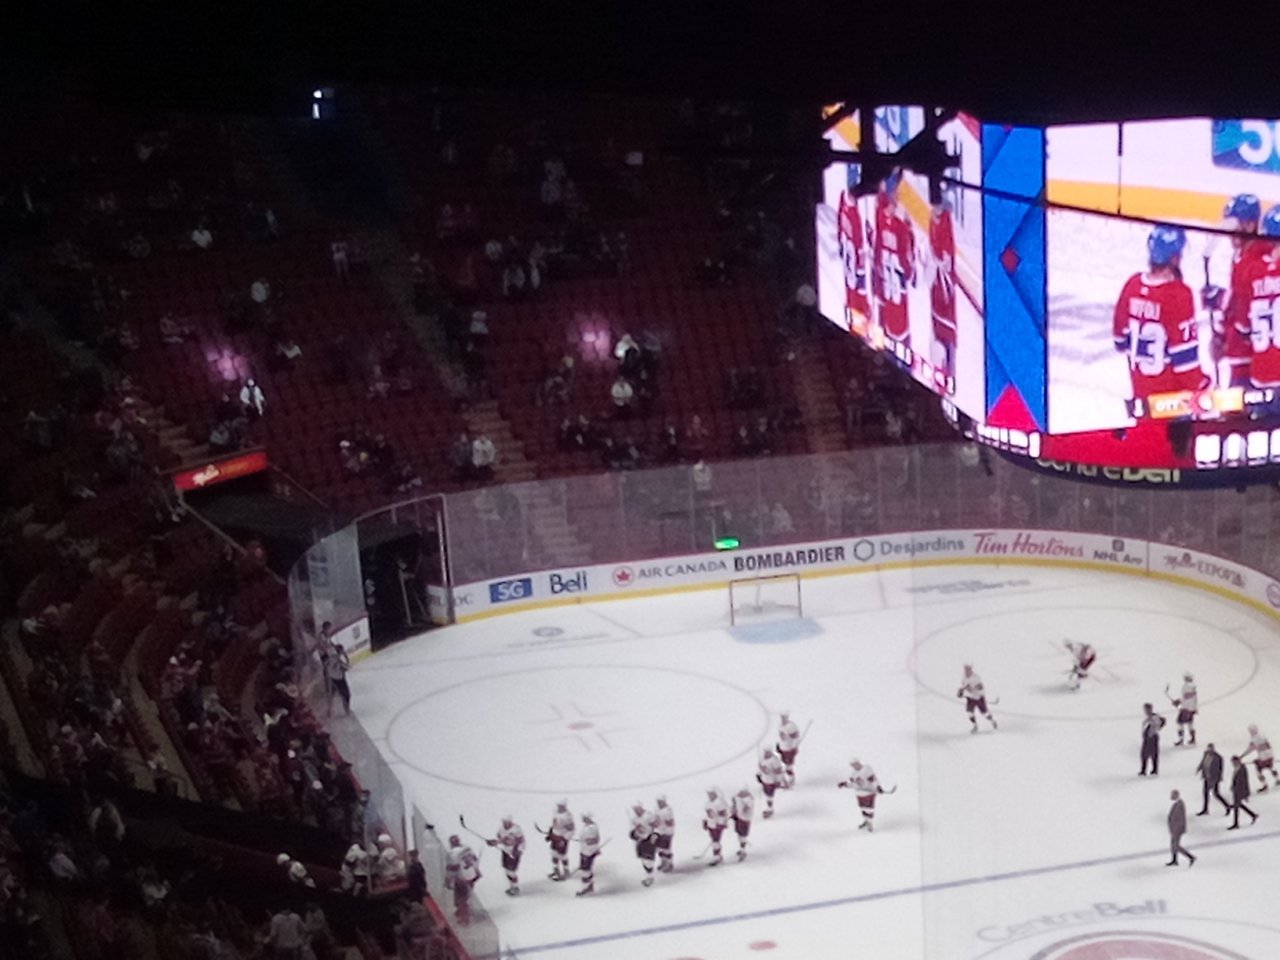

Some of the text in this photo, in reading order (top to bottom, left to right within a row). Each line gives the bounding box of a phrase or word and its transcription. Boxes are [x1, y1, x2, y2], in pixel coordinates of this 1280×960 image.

[880, 536, 964, 558] Desjardins
[973, 531, 1085, 559] Tim Hortons
[637, 559, 728, 580] AIR CANADA
[733, 545, 846, 572] BOMBARDIER
[498, 582, 525, 601] 5G
[549, 571, 588, 595] Bell
